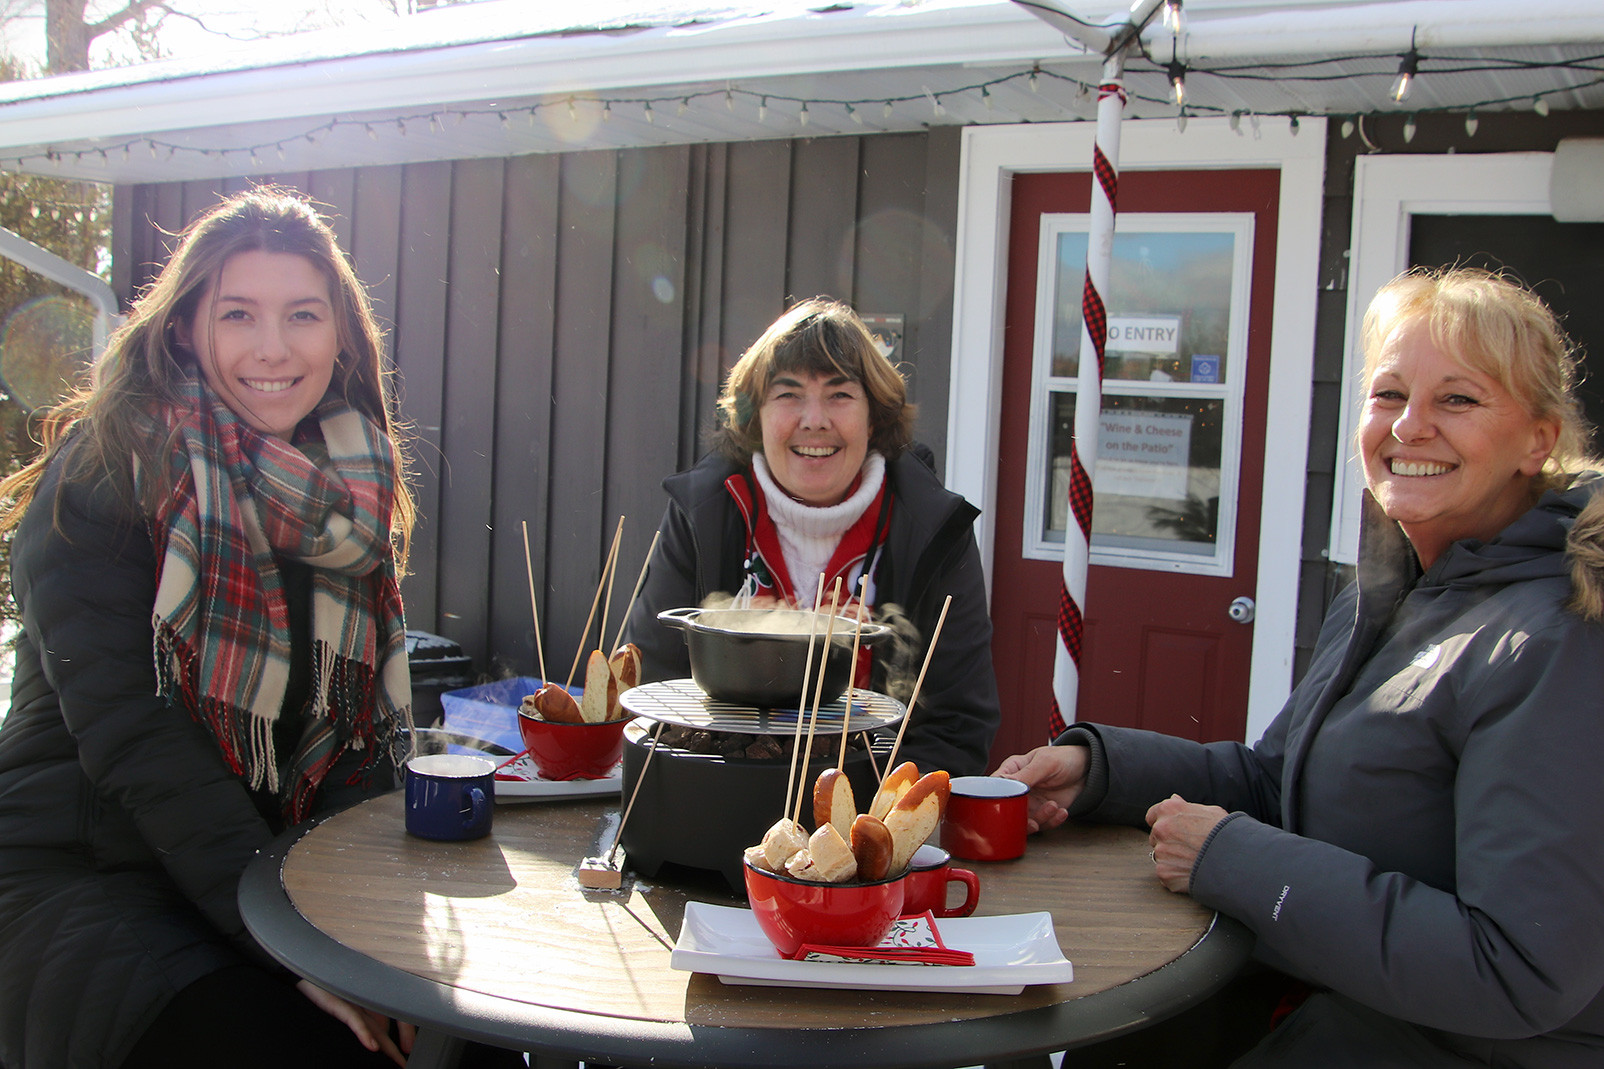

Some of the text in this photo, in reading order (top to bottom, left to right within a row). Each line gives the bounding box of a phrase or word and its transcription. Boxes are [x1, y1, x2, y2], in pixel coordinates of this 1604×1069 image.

[1108, 326, 1176, 341] O ENTRY
[1134, 424, 1142, 435] &
[1145, 425, 1183, 437] Cheese
[1105, 441, 1174, 454] on the Patio"
[1272, 885, 1290, 921] DRYVENT
